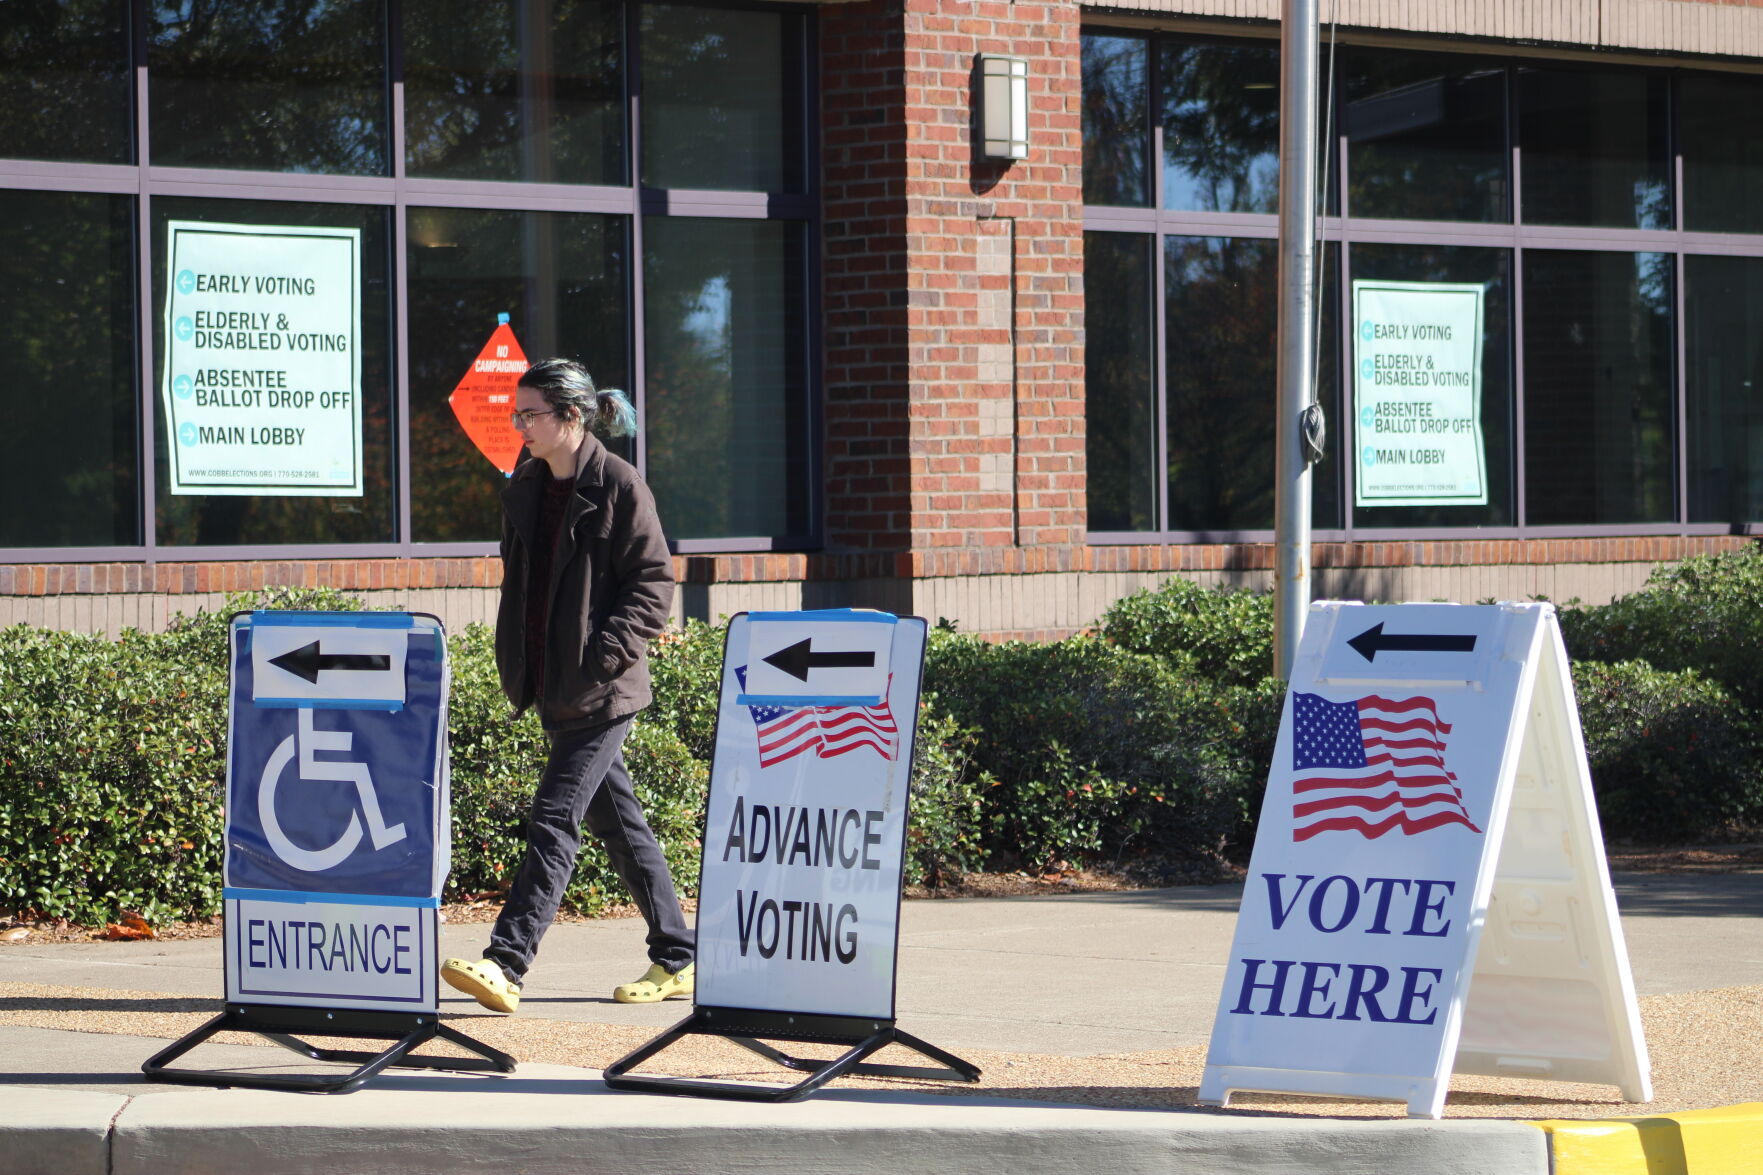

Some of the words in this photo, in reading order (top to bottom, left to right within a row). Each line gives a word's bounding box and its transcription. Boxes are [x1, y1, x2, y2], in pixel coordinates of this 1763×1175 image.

[197, 274, 250, 293] EARLY
[255, 277, 314, 295] VOTING
[195, 311, 270, 330] ELDERLY
[276, 313, 289, 331] &
[195, 330, 282, 350] DISABLED
[287, 334, 346, 352] VOTING
[1374, 324, 1409, 339] EARLY
[1412, 325, 1451, 340] VOTING
[496, 345, 508, 358] NO
[475, 360, 527, 373] CAMPAIGNING
[1374, 354, 1423, 371] ELDERLY
[1426, 355, 1434, 370] &
[194, 369, 286, 388] ABSENTEE
[1375, 370, 1429, 386] DISABLED
[1432, 371, 1469, 386] VOTING
[196, 389, 262, 407] BALLOT
[268, 391, 314, 408] DROP
[320, 392, 350, 409] OFF
[1374, 402, 1432, 417] ABSENTEE
[1375, 418, 1416, 433] BALLOT
[1420, 418, 1449, 433] DROP
[1452, 418, 1472, 433] OFF
[199, 427, 244, 444] MAIN
[251, 428, 304, 445] LOBBY
[1376, 449, 1405, 464] MAIN
[1410, 449, 1445, 464] LOBBY
[723, 796, 884, 870] ADVANCE
[1262, 874, 1456, 937] VOTE
[737, 890, 858, 964] VOTING
[249, 920, 411, 974] ENTRANCE
[1230, 959, 1443, 1025] HERE
